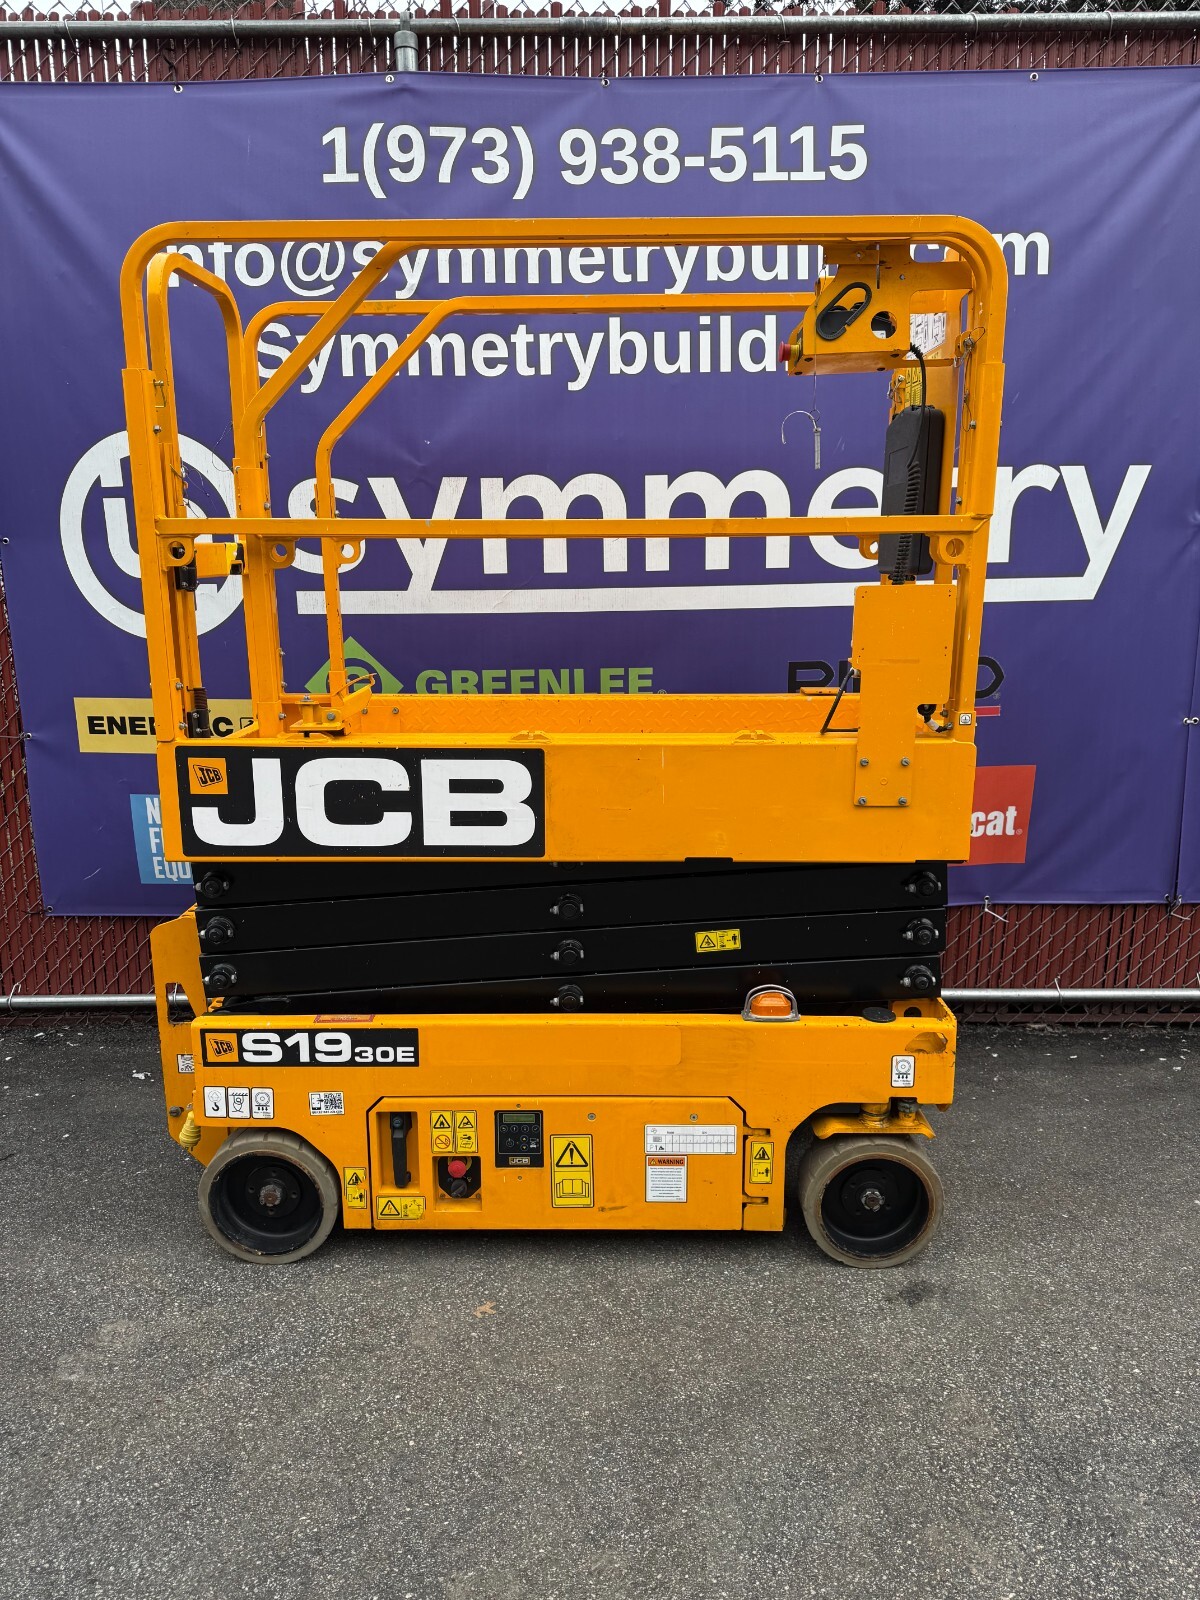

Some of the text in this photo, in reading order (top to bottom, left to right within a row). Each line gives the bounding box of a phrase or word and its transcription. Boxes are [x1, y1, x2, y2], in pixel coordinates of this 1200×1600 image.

[322, 122, 868, 199] 1(973) 938-5115
[287, 464, 1152, 599] symmery
[191, 757, 536, 847] JCB
[198, 767, 221, 784] JCB
[213, 1040, 233, 1055] JCB
